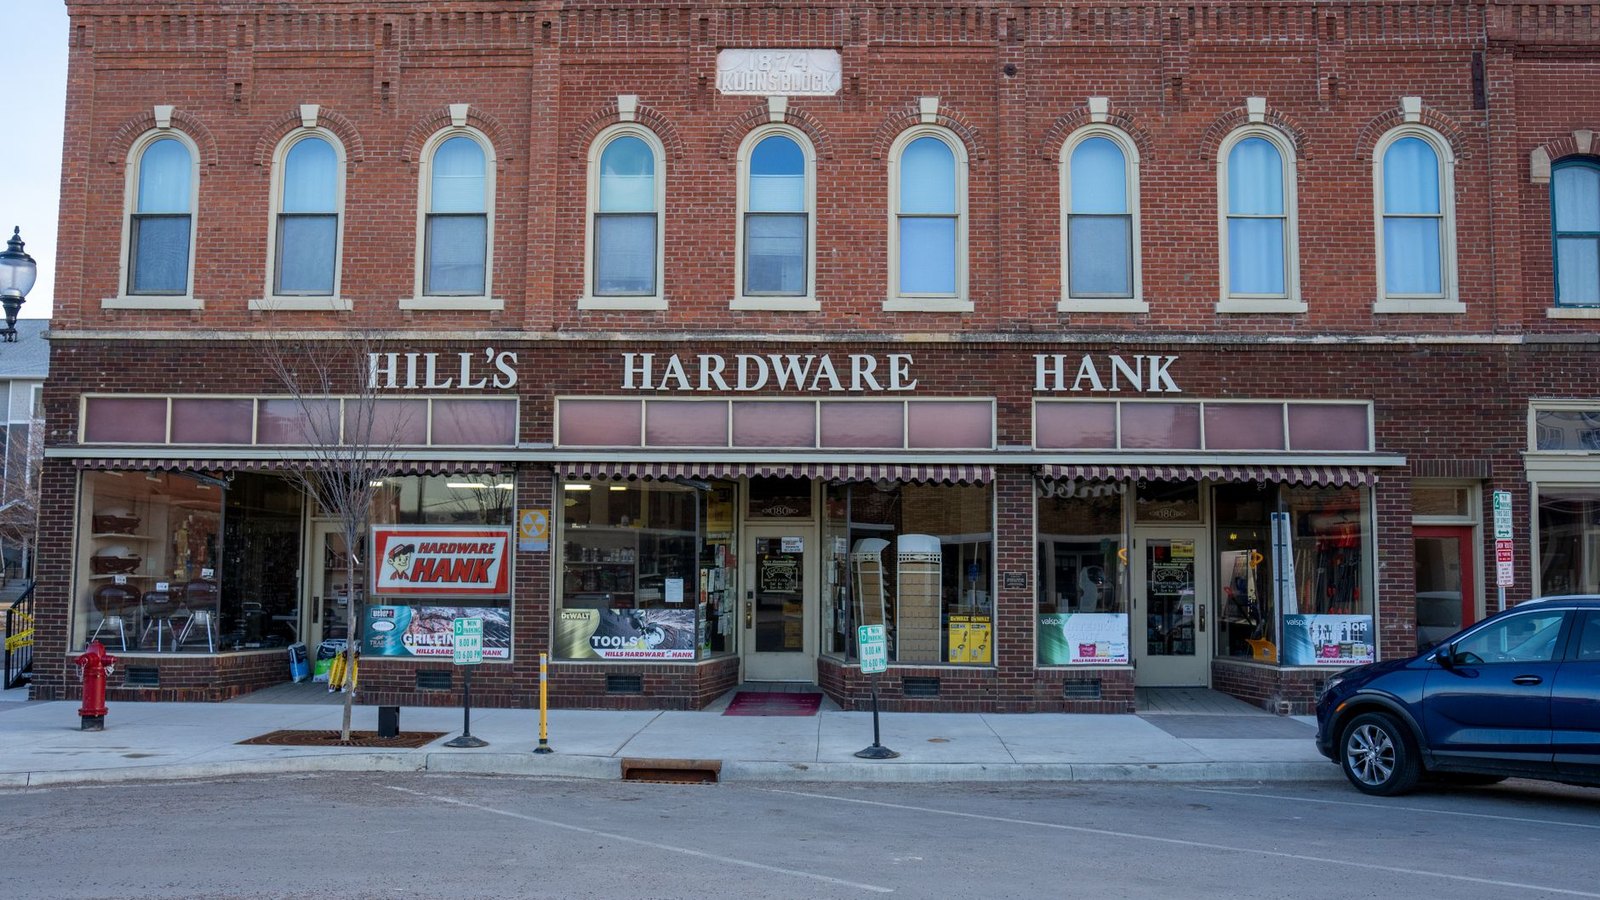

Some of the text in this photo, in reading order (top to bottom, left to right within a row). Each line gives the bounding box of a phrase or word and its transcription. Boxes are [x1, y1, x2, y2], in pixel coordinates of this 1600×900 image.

[747, 52, 808, 72] 1874
[780, 72, 834, 92] BLOCK
[367, 347, 1182, 392] HILL'S HARDWARE HANK
[418, 542, 496, 554] HARDWARE
[409, 558, 496, 583] HANK
[1286, 619, 1309, 627] valspa
[1312, 622, 1367, 631] EXTERIOR
[403, 633, 454, 645] GRILLIN
[592, 636, 638, 647] TOOLS
